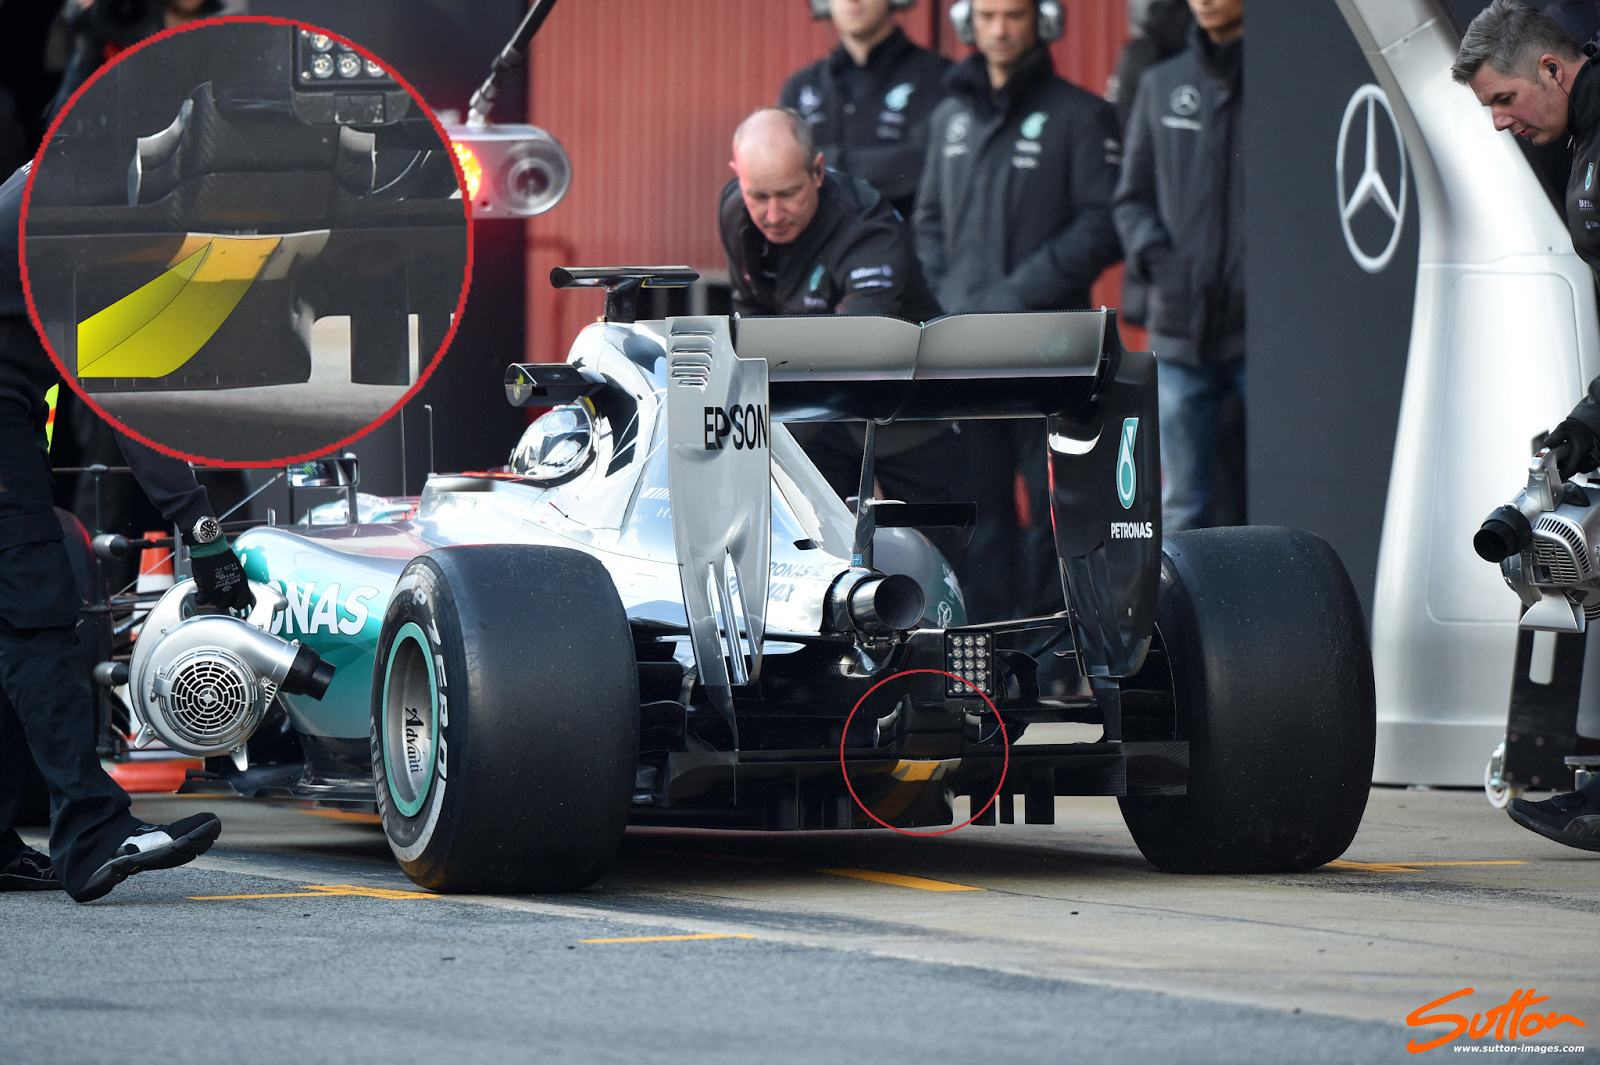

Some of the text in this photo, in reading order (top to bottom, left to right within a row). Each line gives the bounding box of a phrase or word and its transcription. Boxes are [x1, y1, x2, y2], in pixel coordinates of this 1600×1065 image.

[704, 404, 767, 450] EPSON
[1110, 521, 1153, 538] PETRONAS
[427, 618, 449, 779] ZERO
[405, 707, 425, 774] Advanti
